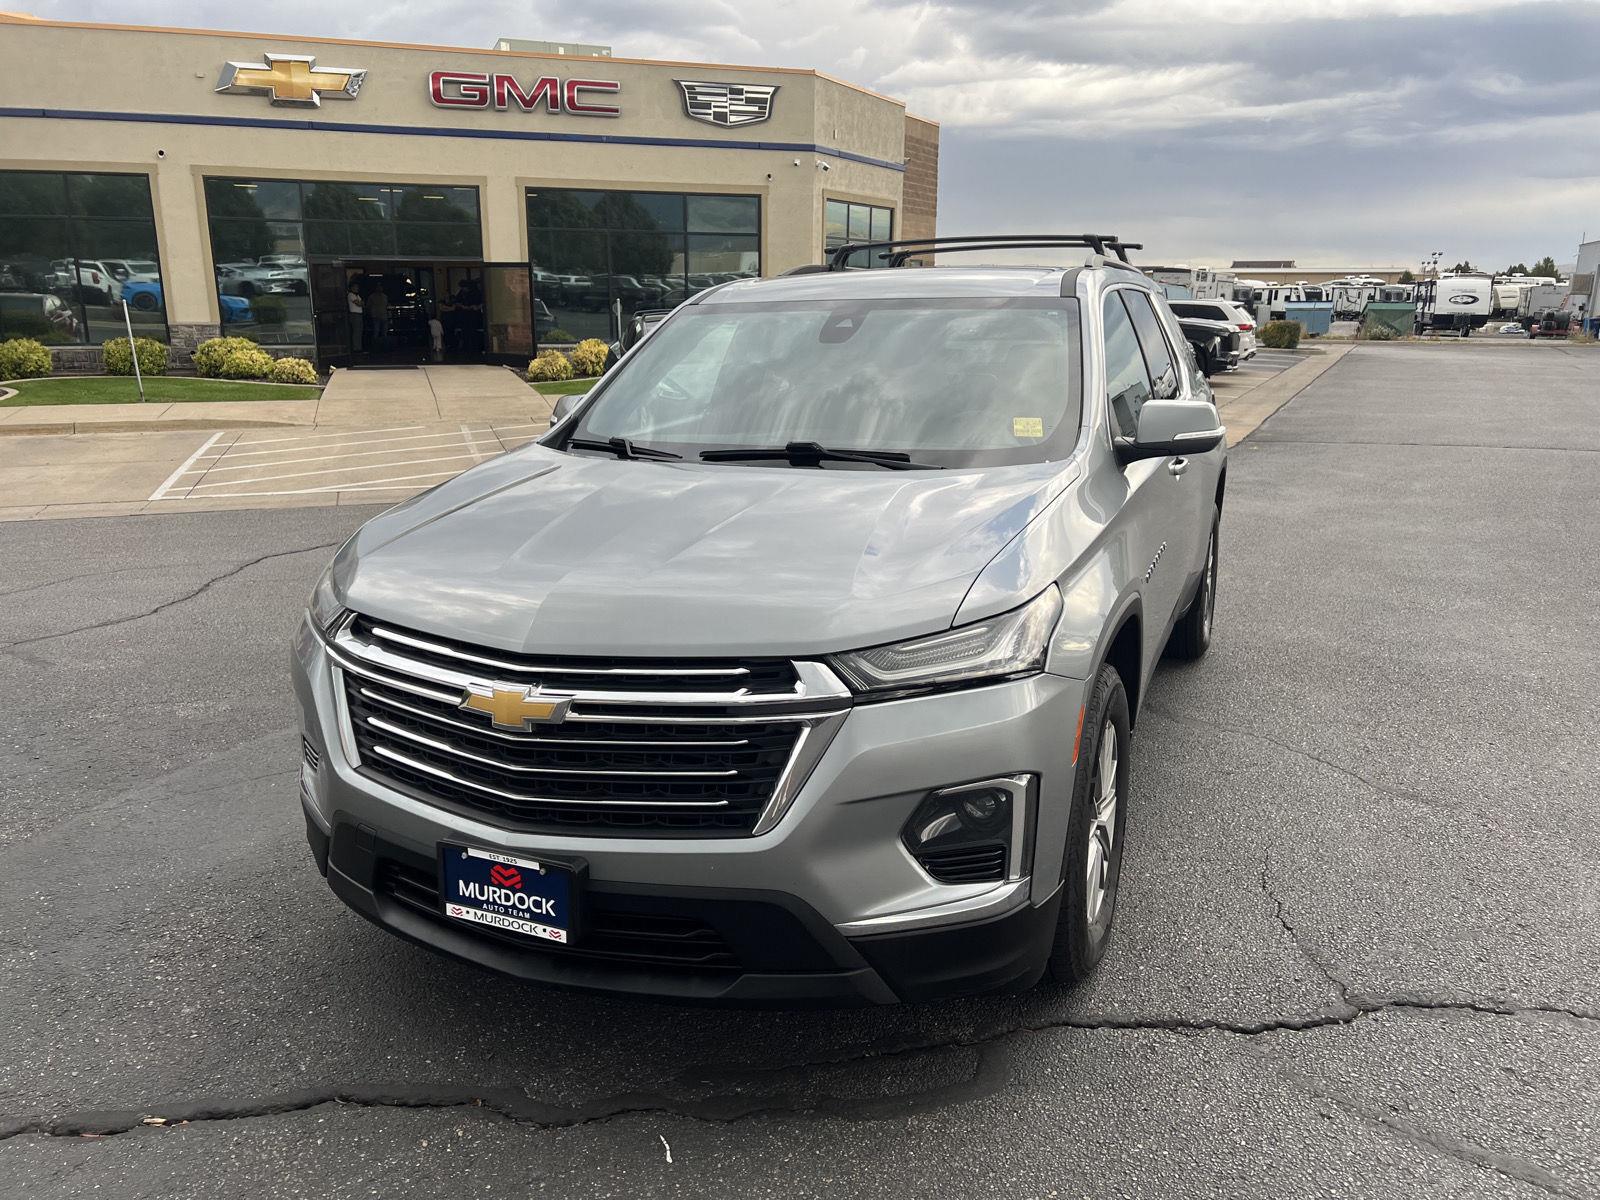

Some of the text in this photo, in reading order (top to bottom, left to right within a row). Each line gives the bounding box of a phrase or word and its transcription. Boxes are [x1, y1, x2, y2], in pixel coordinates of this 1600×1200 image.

[429, 71, 620, 118] GMC
[502, 855, 518, 864] 1925
[458, 879, 556, 917] MURDOCK
[473, 911, 539, 935] MURDOCK
[482, 903, 530, 919] AUTO TEAM
